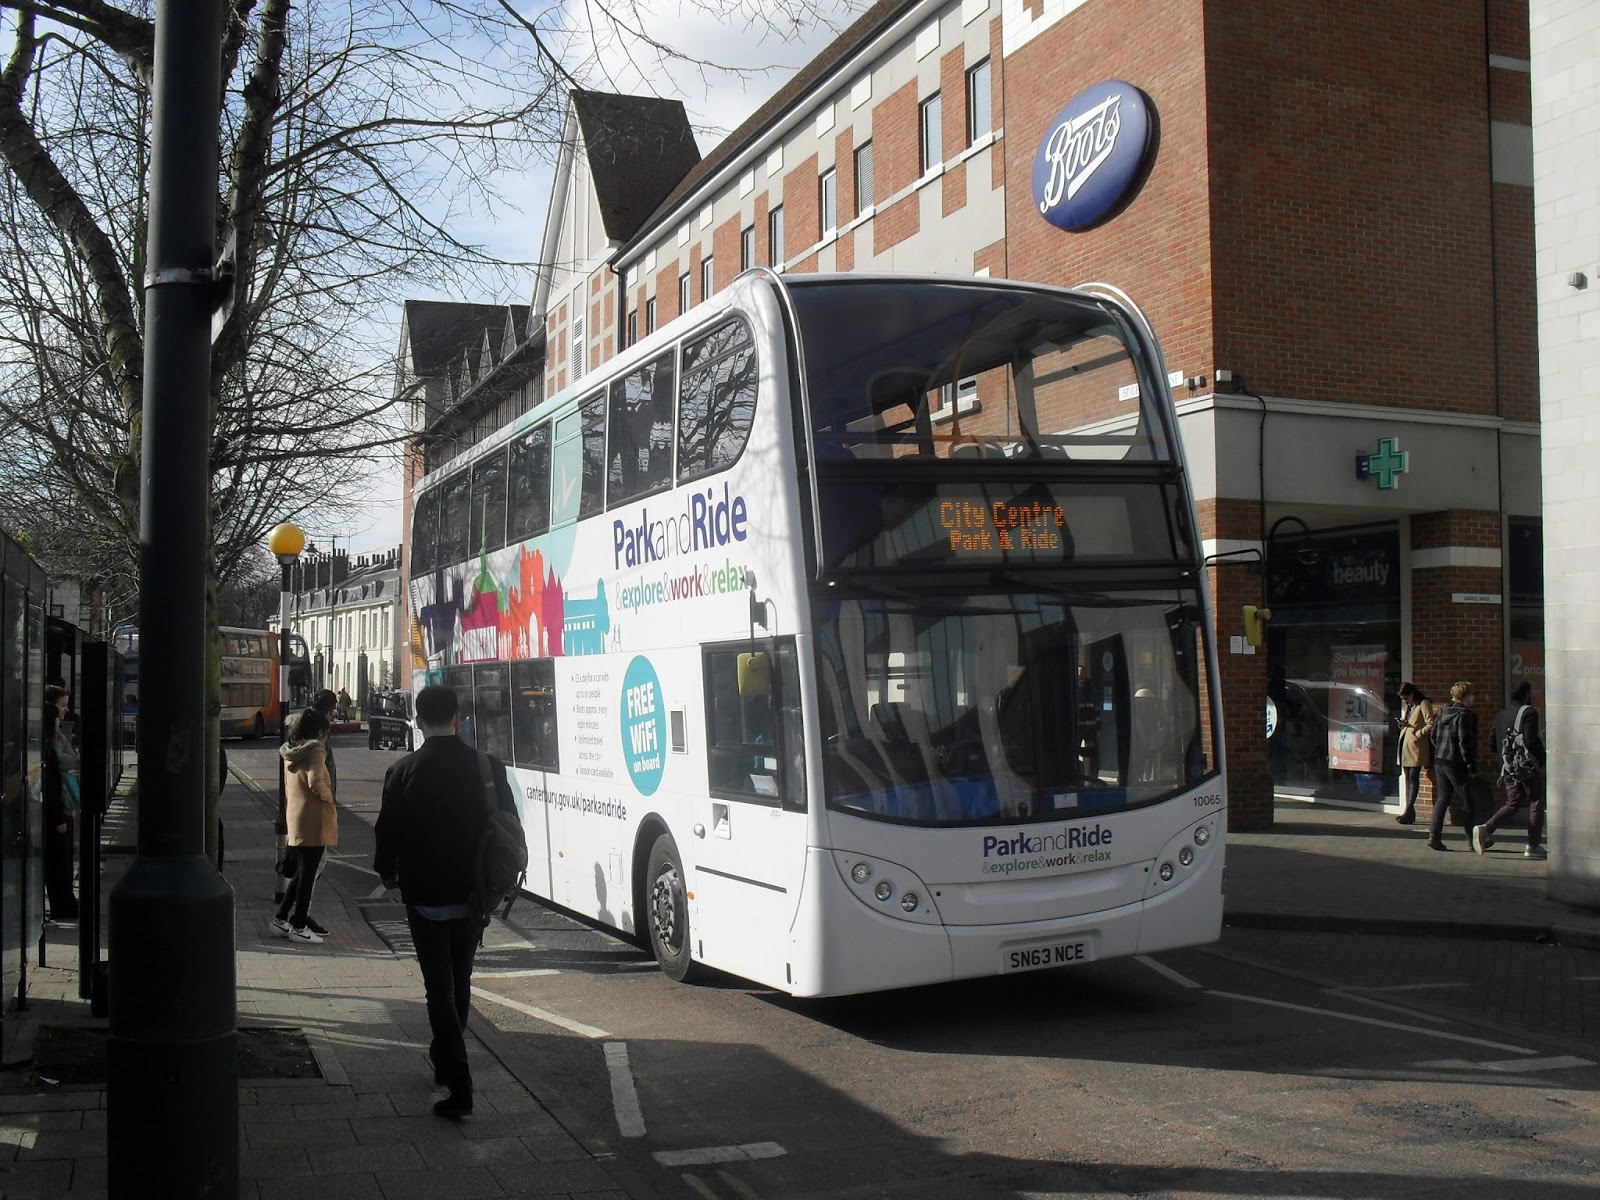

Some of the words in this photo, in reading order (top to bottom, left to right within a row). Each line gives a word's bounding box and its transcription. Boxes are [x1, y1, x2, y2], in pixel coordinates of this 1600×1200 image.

[1040, 94, 1122, 214] Boots
[613, 481, 748, 570] ParkandRide
[940, 502, 985, 527] City
[993, 502, 1064, 527] Centre
[950, 529, 992, 550] Park
[1021, 529, 1058, 550] Ride
[1334, 561, 1389, 586] beauty
[1334, 652, 1355, 663] Show
[1332, 668, 1347, 678] you
[1350, 666, 1366, 676] love
[1367, 667, 1380, 676] her
[626, 681, 656, 719] FREE
[630, 718, 658, 754] WiFi
[634, 761, 641, 773] on
[642, 753, 660, 772] board
[526, 786, 627, 821] canterbury.gov.uk/parkandride
[1193, 794, 1220, 807] 10065
[983, 824, 1112, 858] ParkandRide
[982, 850, 1112, 875] &explore&work&relax
[1010, 948, 1050, 968] SN63
[1055, 943, 1084, 962] NCE
